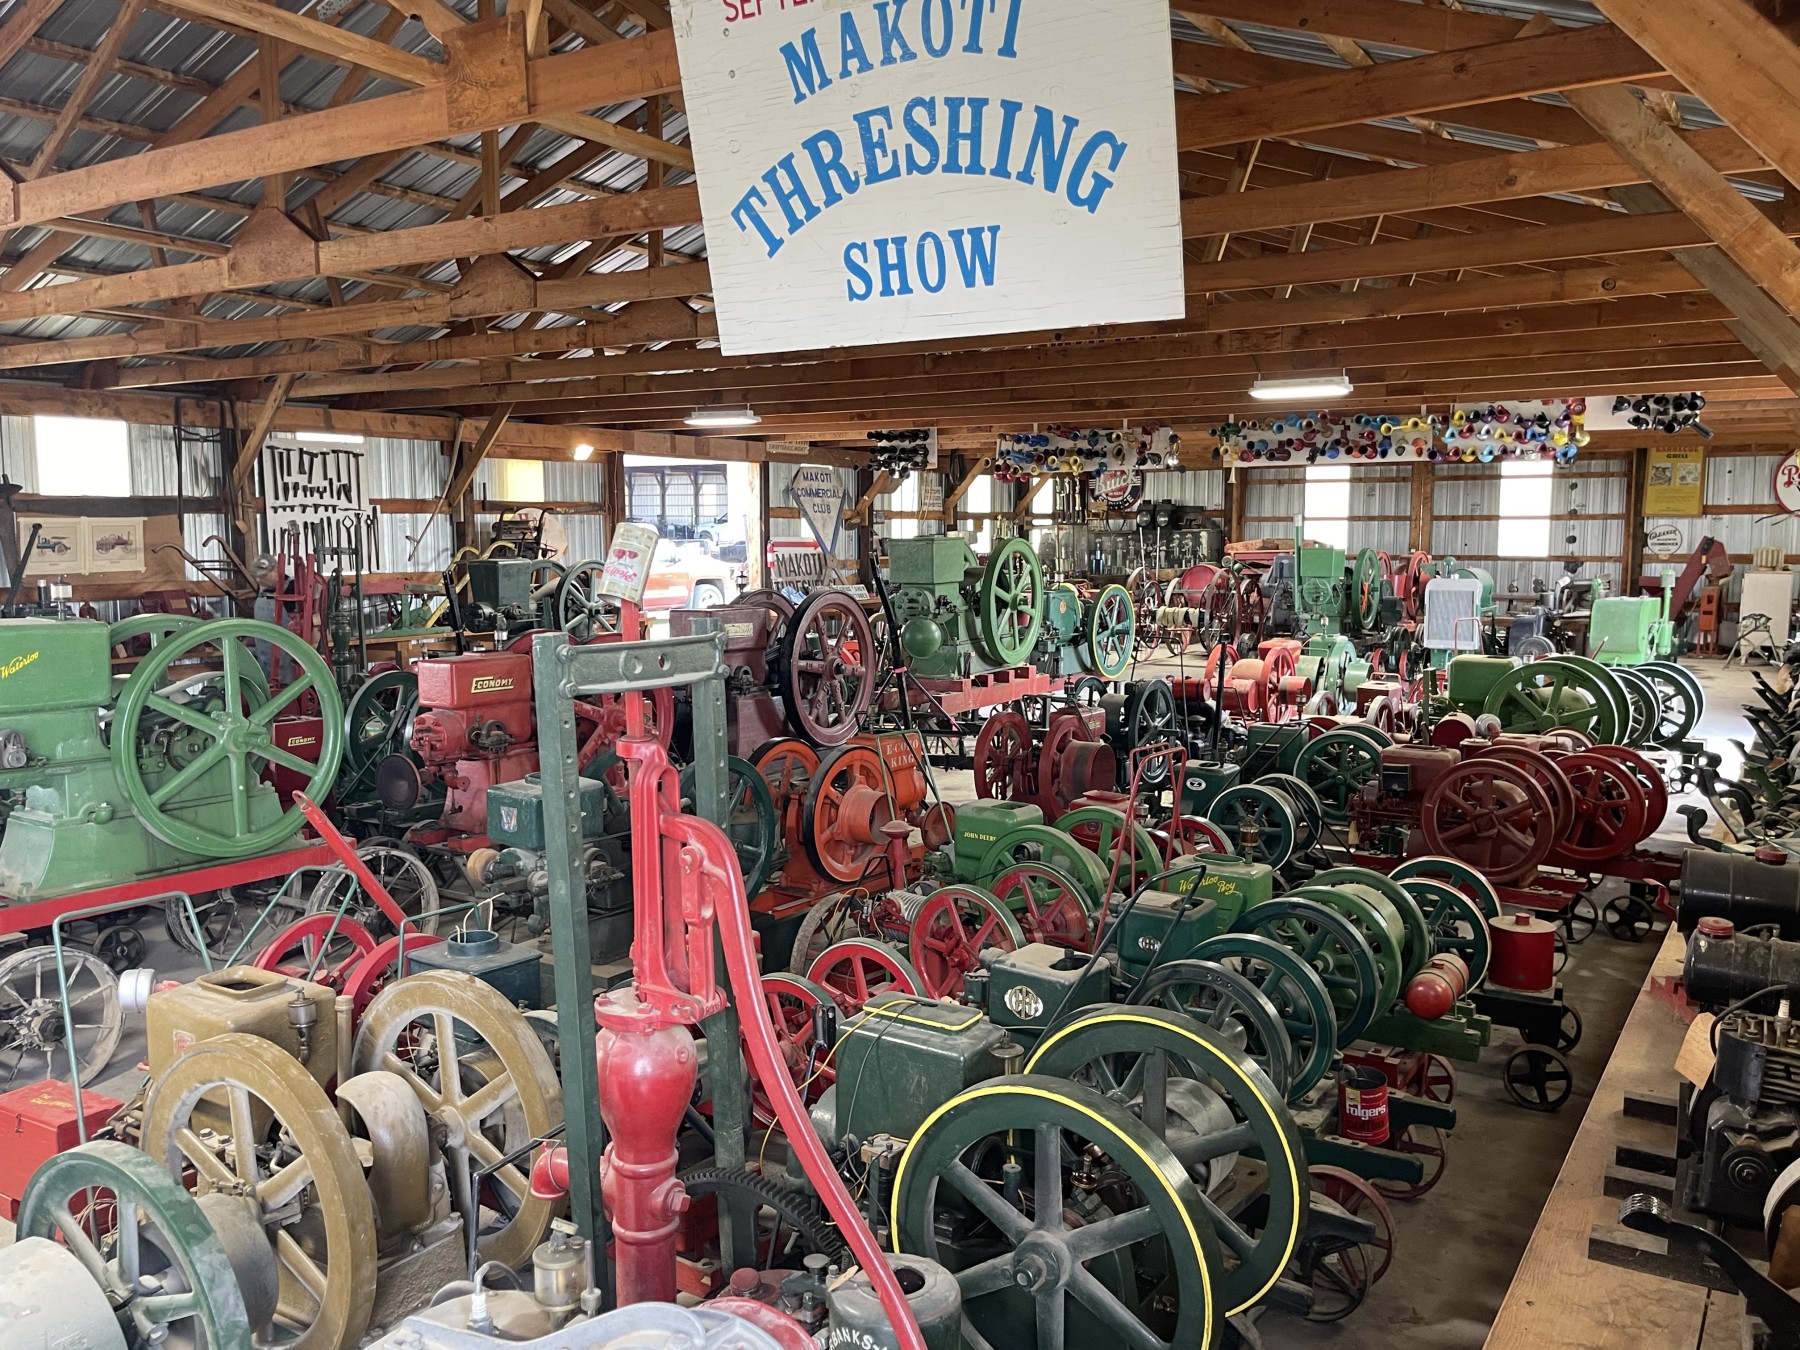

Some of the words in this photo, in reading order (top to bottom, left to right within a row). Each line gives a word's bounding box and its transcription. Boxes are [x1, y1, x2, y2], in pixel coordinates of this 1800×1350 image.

[779, 0, 1022, 104] MAKOTI
[731, 96, 1128, 258] THRESHING
[844, 225, 1000, 302] SHOW
[802, 471, 832, 483] MAKOTI
[1094, 469, 1139, 497] Buick
[796, 487, 842, 499] COMMERCIAL
[812, 503, 832, 514] CLUB
[775, 553, 823, 578] MAKOTI
[471, 676, 514, 693] ECONOMY
[288, 736, 316, 747] ECONOMY
[964, 831, 978, 839] JOHN
[1179, 875, 1219, 892] Warloo
